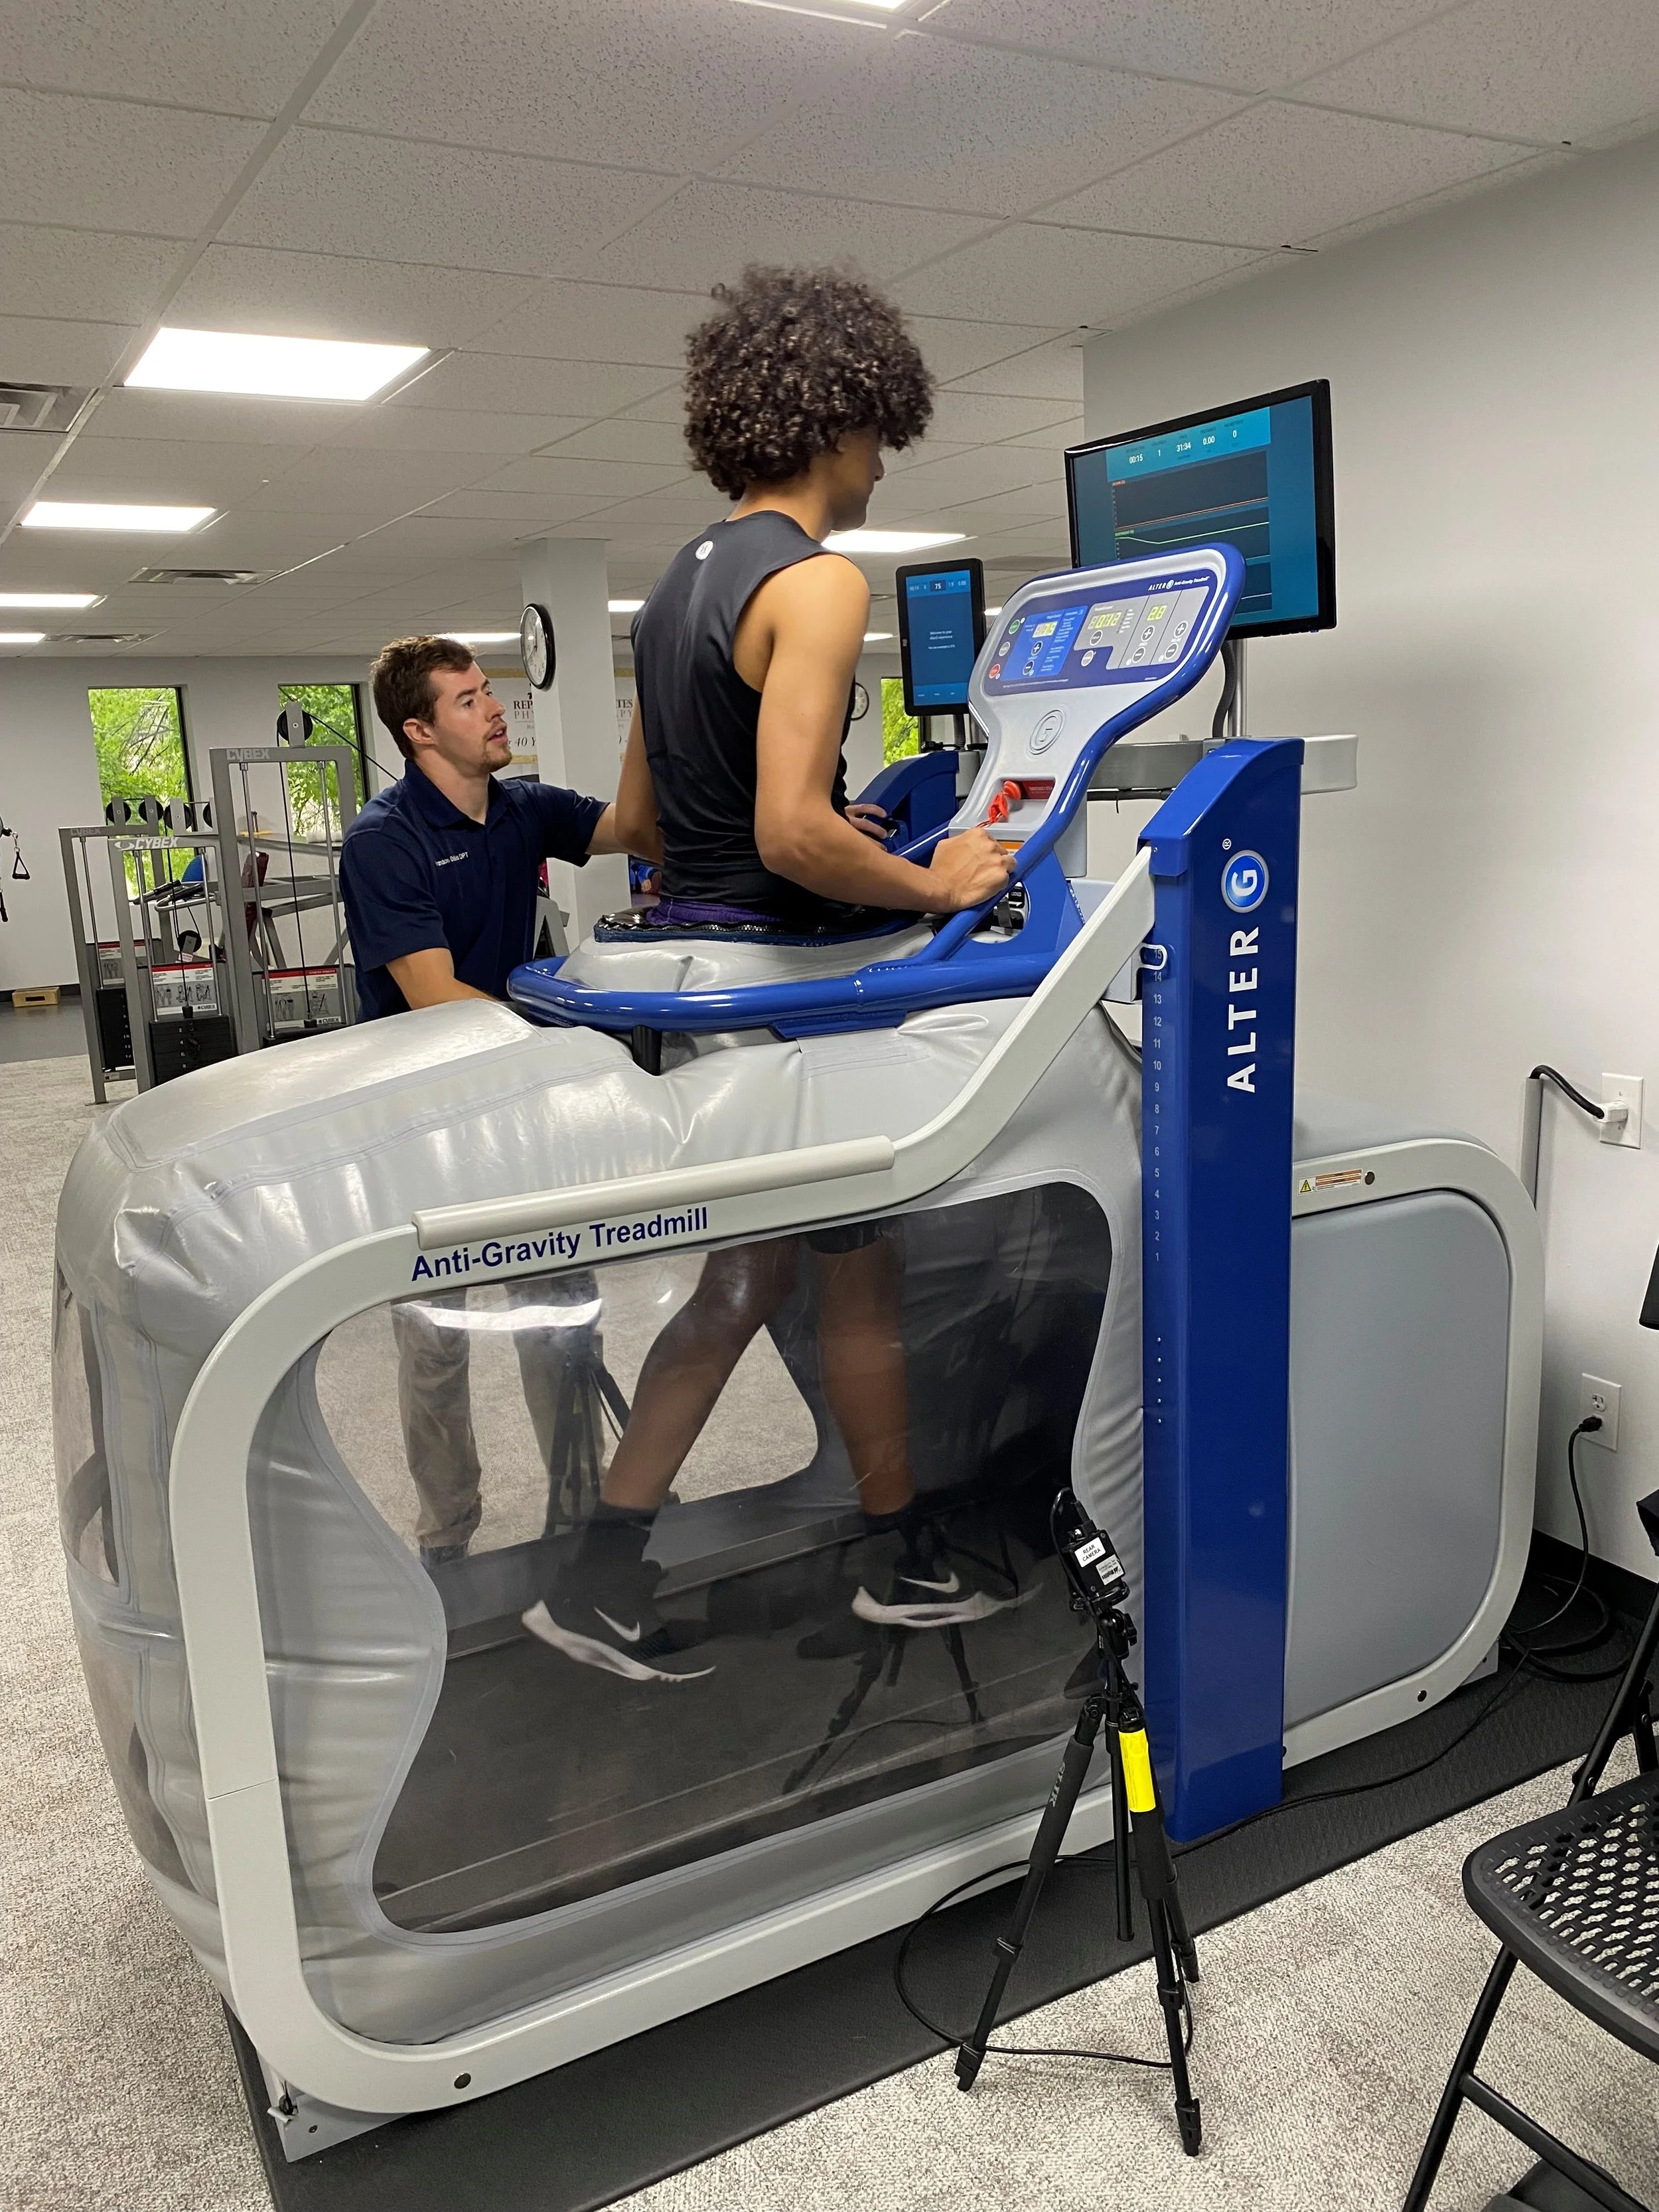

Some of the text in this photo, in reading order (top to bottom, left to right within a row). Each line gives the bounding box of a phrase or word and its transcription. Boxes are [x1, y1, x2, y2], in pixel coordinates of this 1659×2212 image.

[1129, 454, 1143, 464] 00:15
[1176, 441, 1191, 452] 31:34
[1202, 435, 1215, 445] 0.00
[1232, 429, 1237, 438] 0
[616, 699, 633, 708] TES
[515, 737, 528, 747] 40
[226, 748, 271, 762] CYBEX
[70, 828, 102, 837] CYBEX
[135, 837, 179, 850] CYBEX
[1154, 949, 1162, 959] 15
[1153, 972, 1162, 982] 14
[1153, 994, 1162, 1004] 13
[1153, 1016, 1162, 1027] 12
[1153, 1039, 1161, 1049] 11
[1153, 1061, 1161, 1070] 10
[1155, 1082, 1159, 1092] 9
[1155, 1104, 1159, 1114] 8
[1155, 1126, 1159, 1135] 7
[1155, 1147, 1159, 1156] 6
[1155, 1168, 1159, 1177] 5
[1155, 1189, 1159, 1199] 4
[1155, 1210, 1159, 1220] 3
[1155, 1231, 1159, 1241] 2
[411, 1207, 708, 1282] Anti-Gravity Treadmill
[1155, 1252, 1159, 1262] 1
[1082, 1544, 1096, 1554] REAR
[1082, 1548, 1102, 1562] CAMERA
